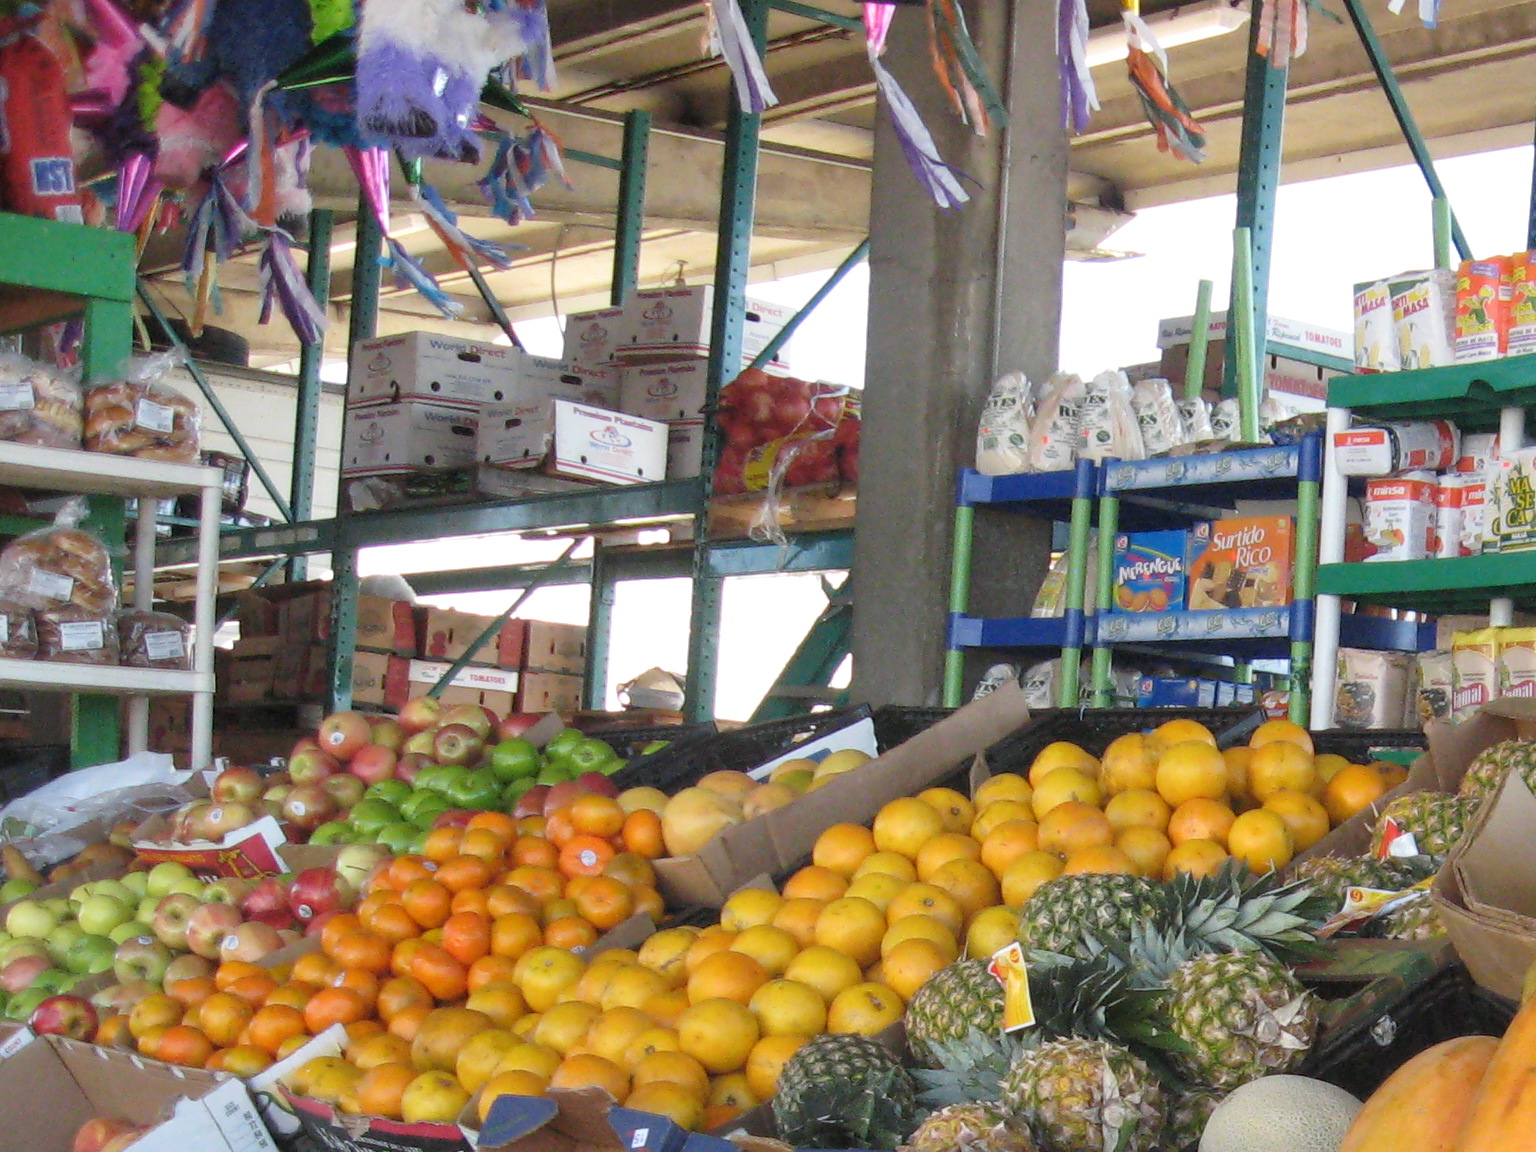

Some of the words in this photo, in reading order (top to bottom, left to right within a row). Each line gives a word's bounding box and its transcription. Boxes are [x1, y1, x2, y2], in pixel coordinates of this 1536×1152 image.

[1361, 296, 1387, 316] MASA
[1403, 297, 1430, 318] MASA
[430, 340, 465, 352] World
[469, 344, 506, 359] Direct
[1305, 331, 1342, 348] TOMATOES
[534, 359, 570, 371] World
[573, 365, 606, 379] Direct
[1373, 486, 1404, 496] minsa
[1468, 488, 1485, 499] min
[1212, 525, 1266, 552] Surtido
[1234, 546, 1272, 569] Rico
[1119, 556, 1183, 585] MERENGUE
